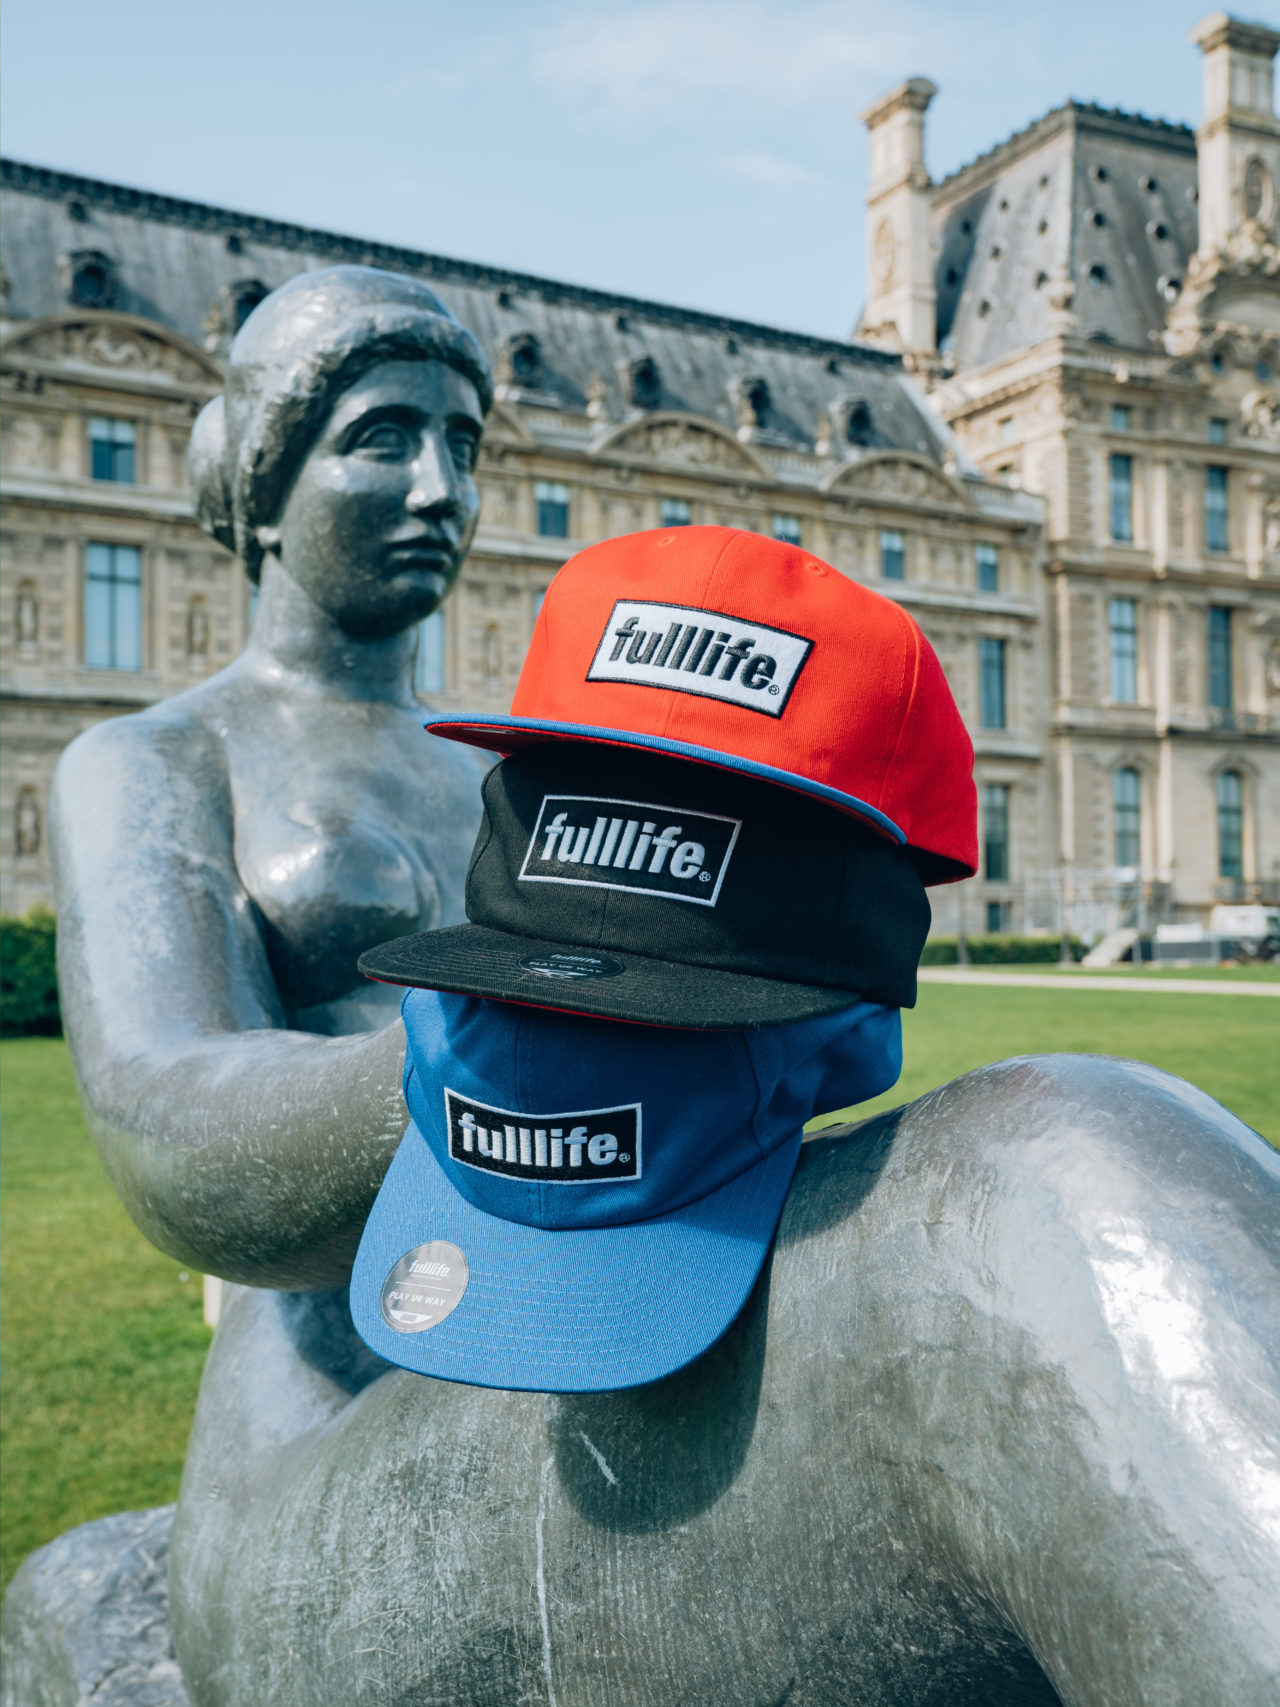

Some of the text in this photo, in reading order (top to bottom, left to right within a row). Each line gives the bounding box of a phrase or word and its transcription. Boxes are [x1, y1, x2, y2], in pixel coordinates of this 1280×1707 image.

[389, 1290, 447, 1306] PLAY UR WAY
